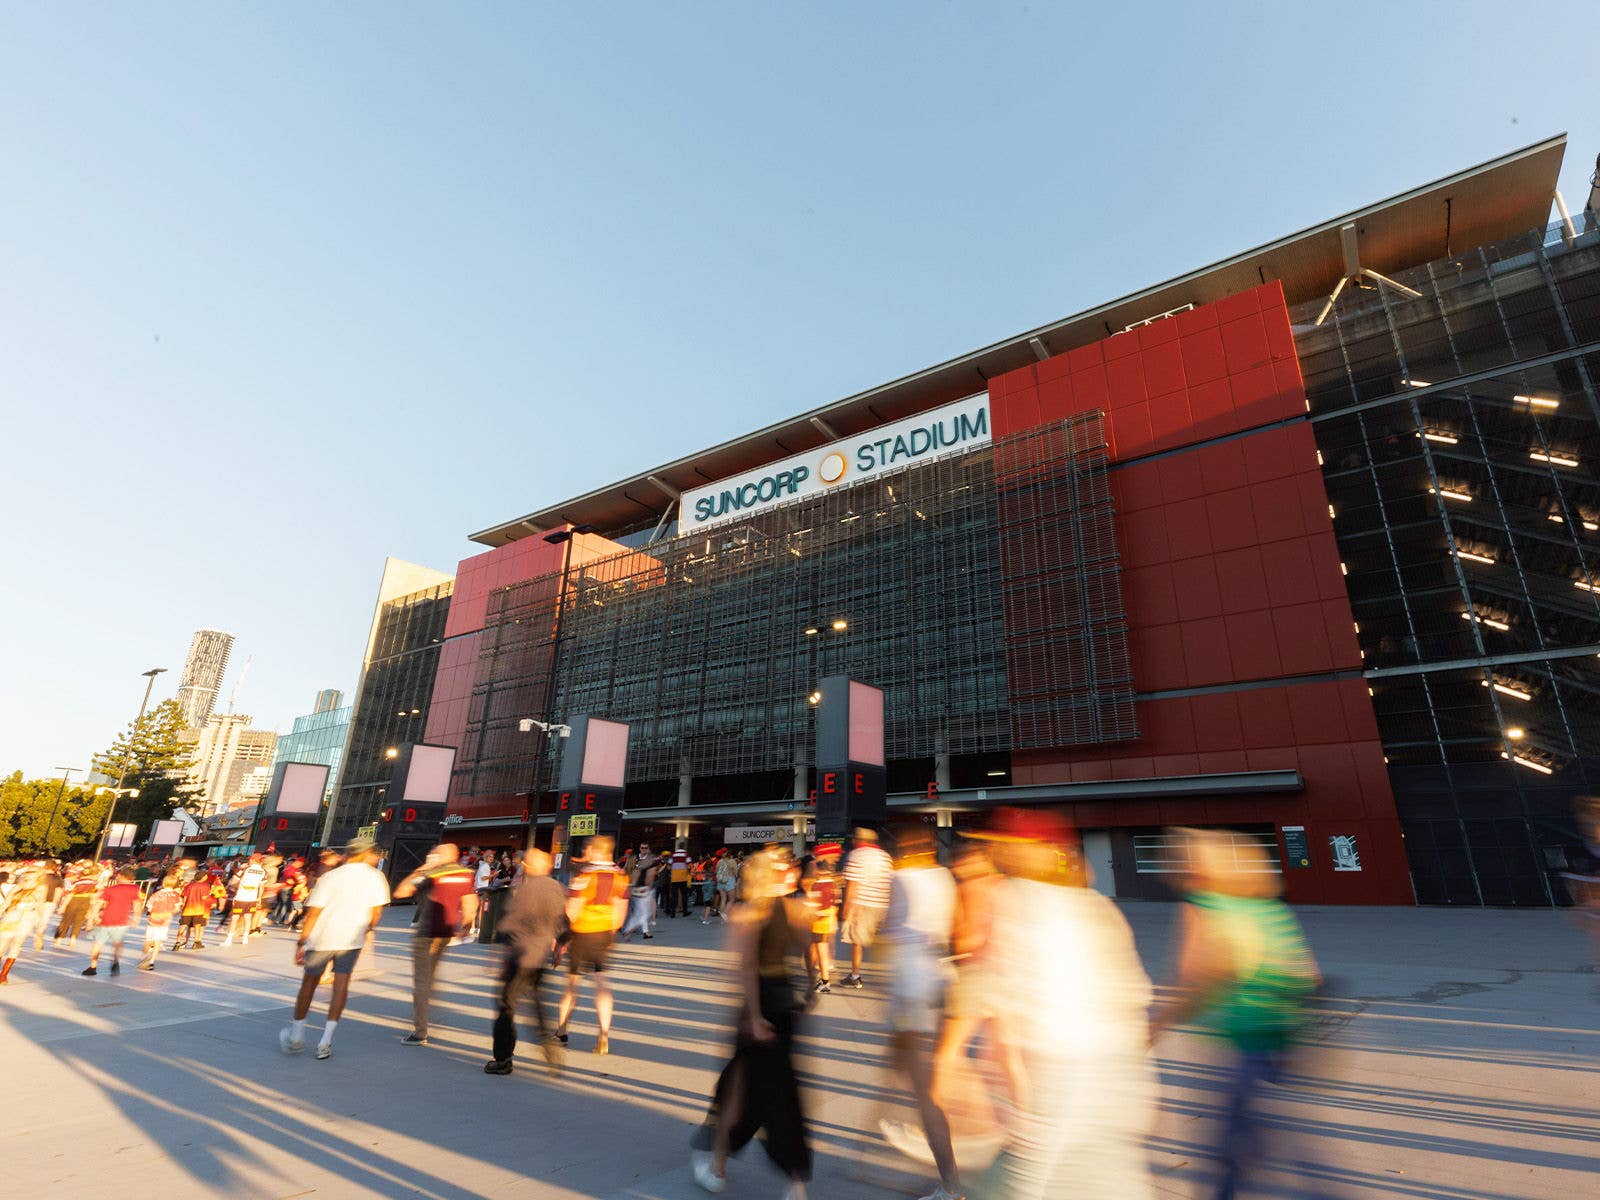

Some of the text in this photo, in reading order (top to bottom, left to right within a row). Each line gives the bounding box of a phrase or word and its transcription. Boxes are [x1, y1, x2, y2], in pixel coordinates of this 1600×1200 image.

[695, 407, 988, 522] SUNCORP STADIUM
[824, 773, 864, 794] E E
[927, 782, 939, 800] E
[560, 792, 597, 811] E E
[277, 818, 289, 831] D
[404, 808, 417, 823] D
[742, 830, 775, 840] SUNCORP
